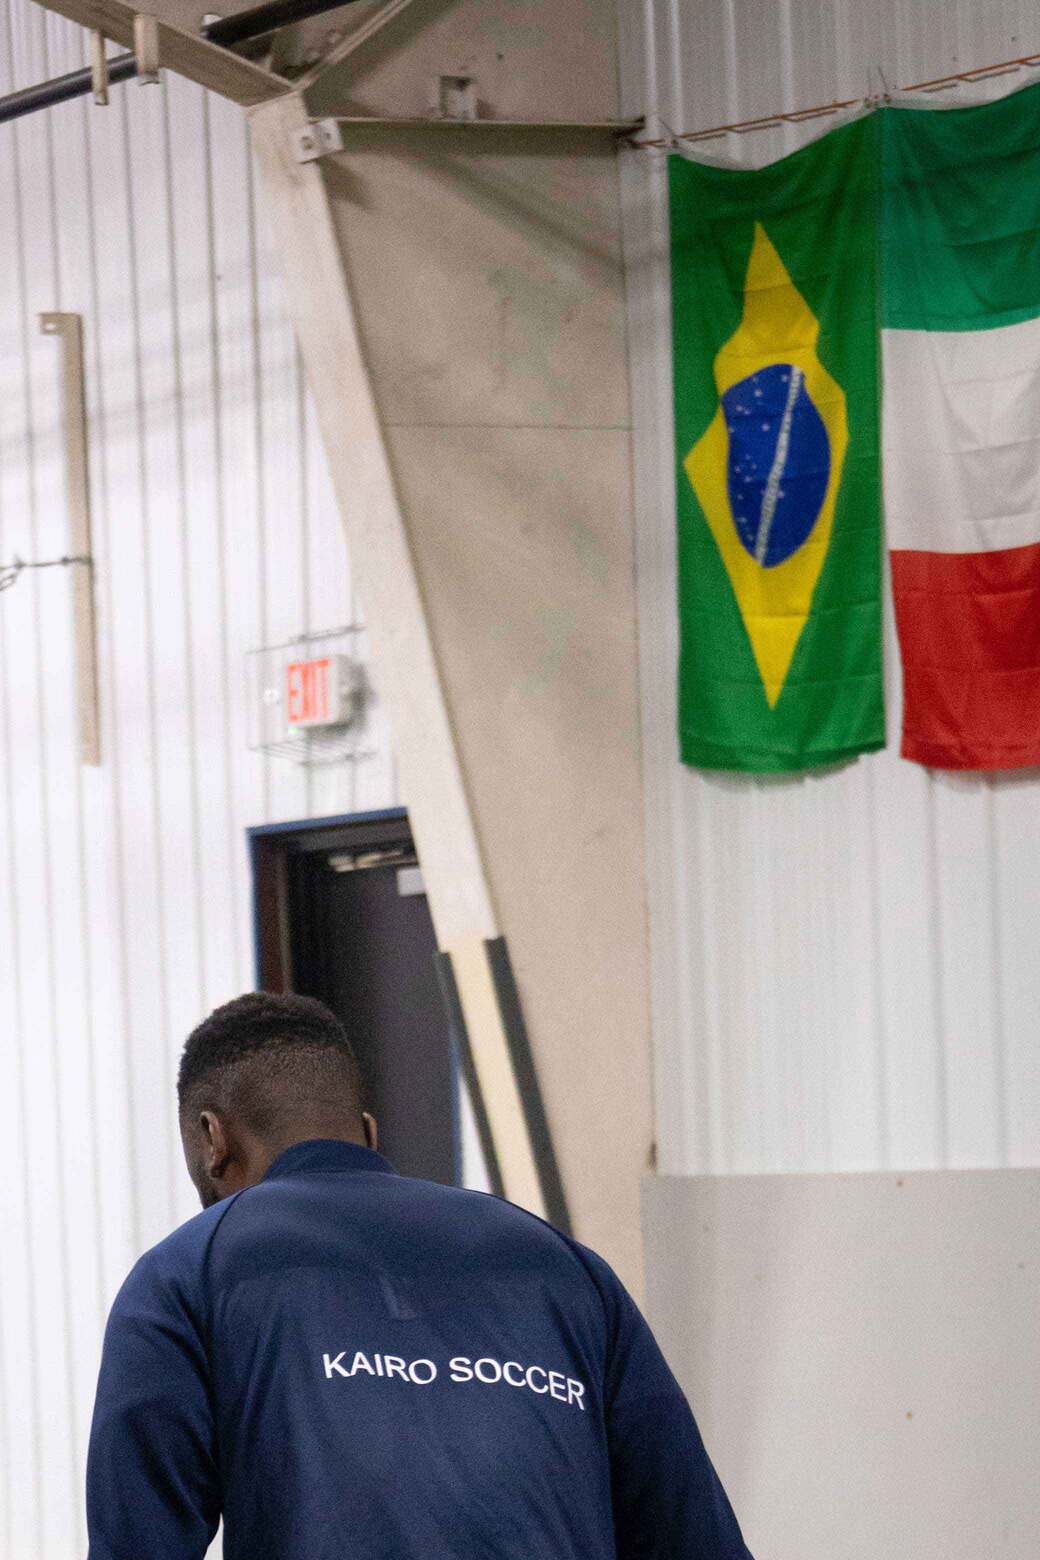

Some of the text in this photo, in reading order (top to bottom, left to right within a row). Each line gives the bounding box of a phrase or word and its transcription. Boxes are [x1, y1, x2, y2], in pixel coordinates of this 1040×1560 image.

[286, 658, 330, 722] EXIT
[322, 1351, 586, 1411] KAIRO SOCCER
